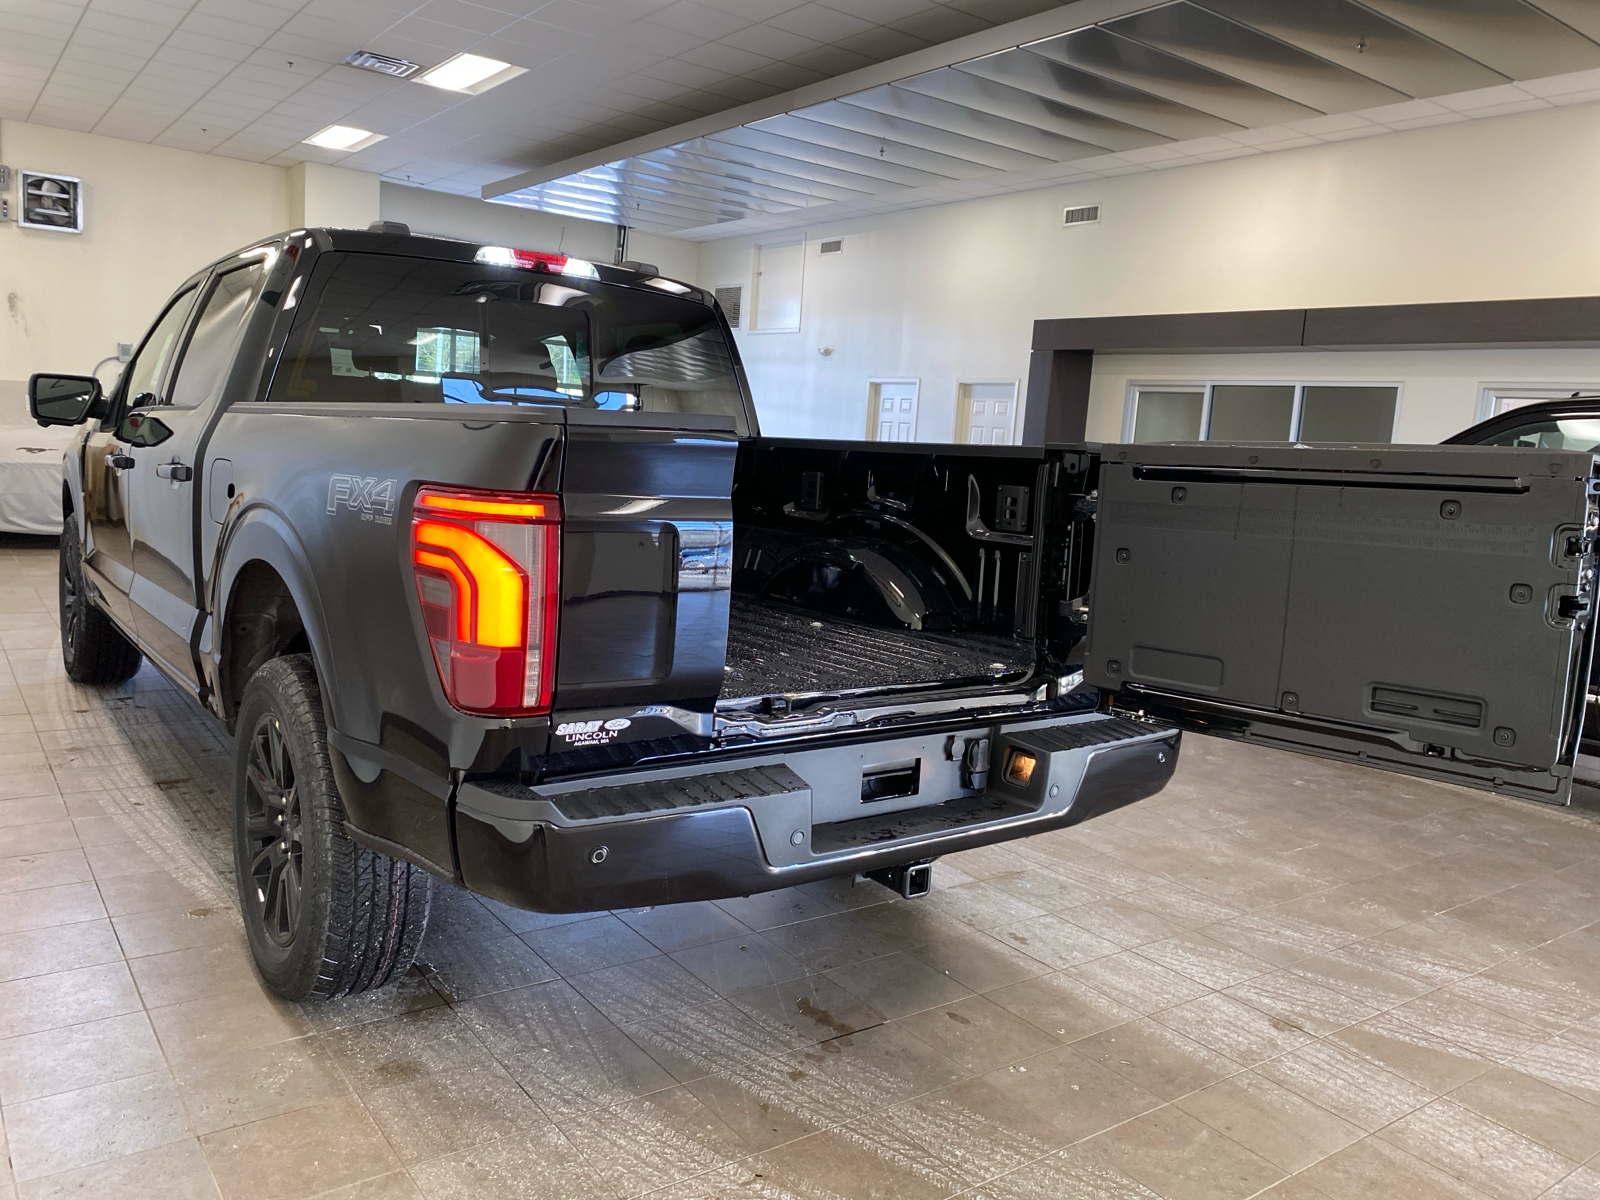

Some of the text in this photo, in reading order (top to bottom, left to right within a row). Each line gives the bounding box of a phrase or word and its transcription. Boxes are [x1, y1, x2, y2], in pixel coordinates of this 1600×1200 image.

[326, 474, 397, 516] FX4
[361, 513, 392, 525] OFF ROAD
[555, 720, 603, 735] SARAT
[566, 730, 618, 742] LINCOLN
